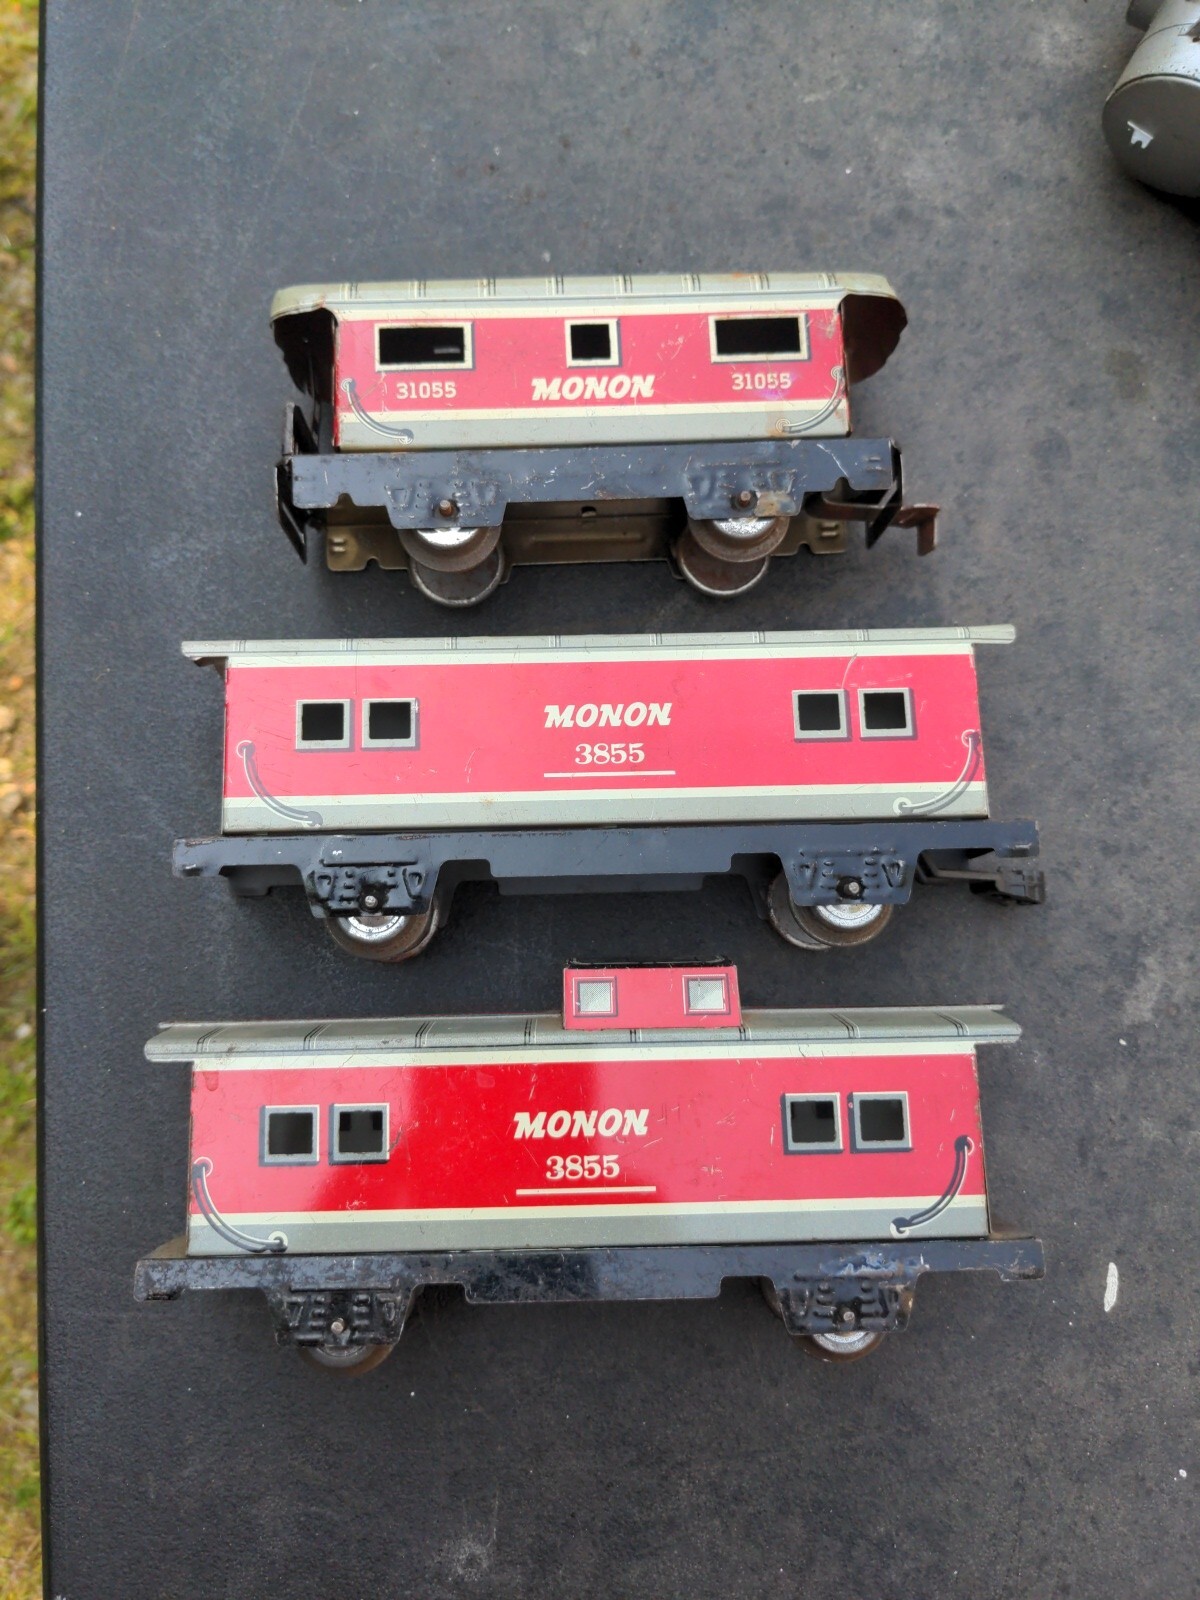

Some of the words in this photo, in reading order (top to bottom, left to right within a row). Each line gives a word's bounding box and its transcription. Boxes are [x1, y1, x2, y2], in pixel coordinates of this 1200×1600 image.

[396, 381, 456, 398] 31055
[531, 375, 654, 401] MONON
[731, 372, 791, 390] 31055
[543, 701, 671, 728] MONON
[575, 742, 645, 765] 3855
[513, 1109, 649, 1139] MONON
[546, 1154, 620, 1180] 3855
